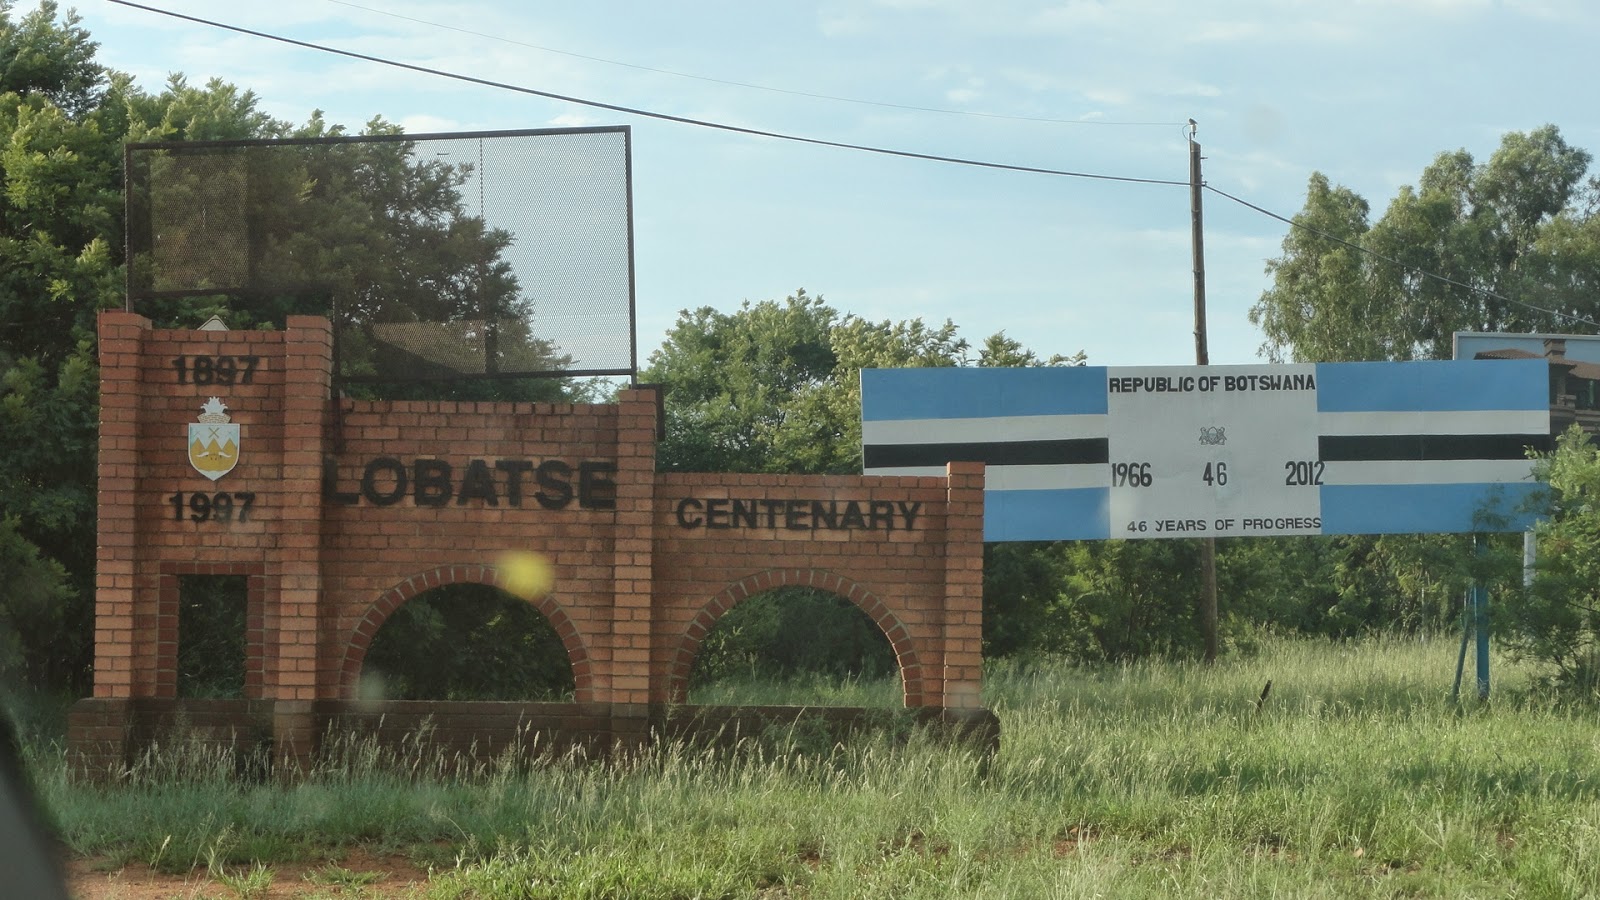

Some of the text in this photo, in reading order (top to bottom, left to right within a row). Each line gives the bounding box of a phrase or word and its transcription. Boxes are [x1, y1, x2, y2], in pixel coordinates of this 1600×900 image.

[172, 354, 259, 386] 1897
[1109, 374, 1316, 393] REPUBLIC OF BOTSWANA
[322, 456, 617, 510] LOBATSE
[1111, 462, 1153, 487] 1966
[1202, 461, 1228, 486] 46
[1285, 460, 1325, 486] 2012
[169, 490, 256, 523] 1997
[676, 497, 921, 530] CENTENARY
[1127, 517, 1322, 533] 46 YEARS OF PROGRESS
